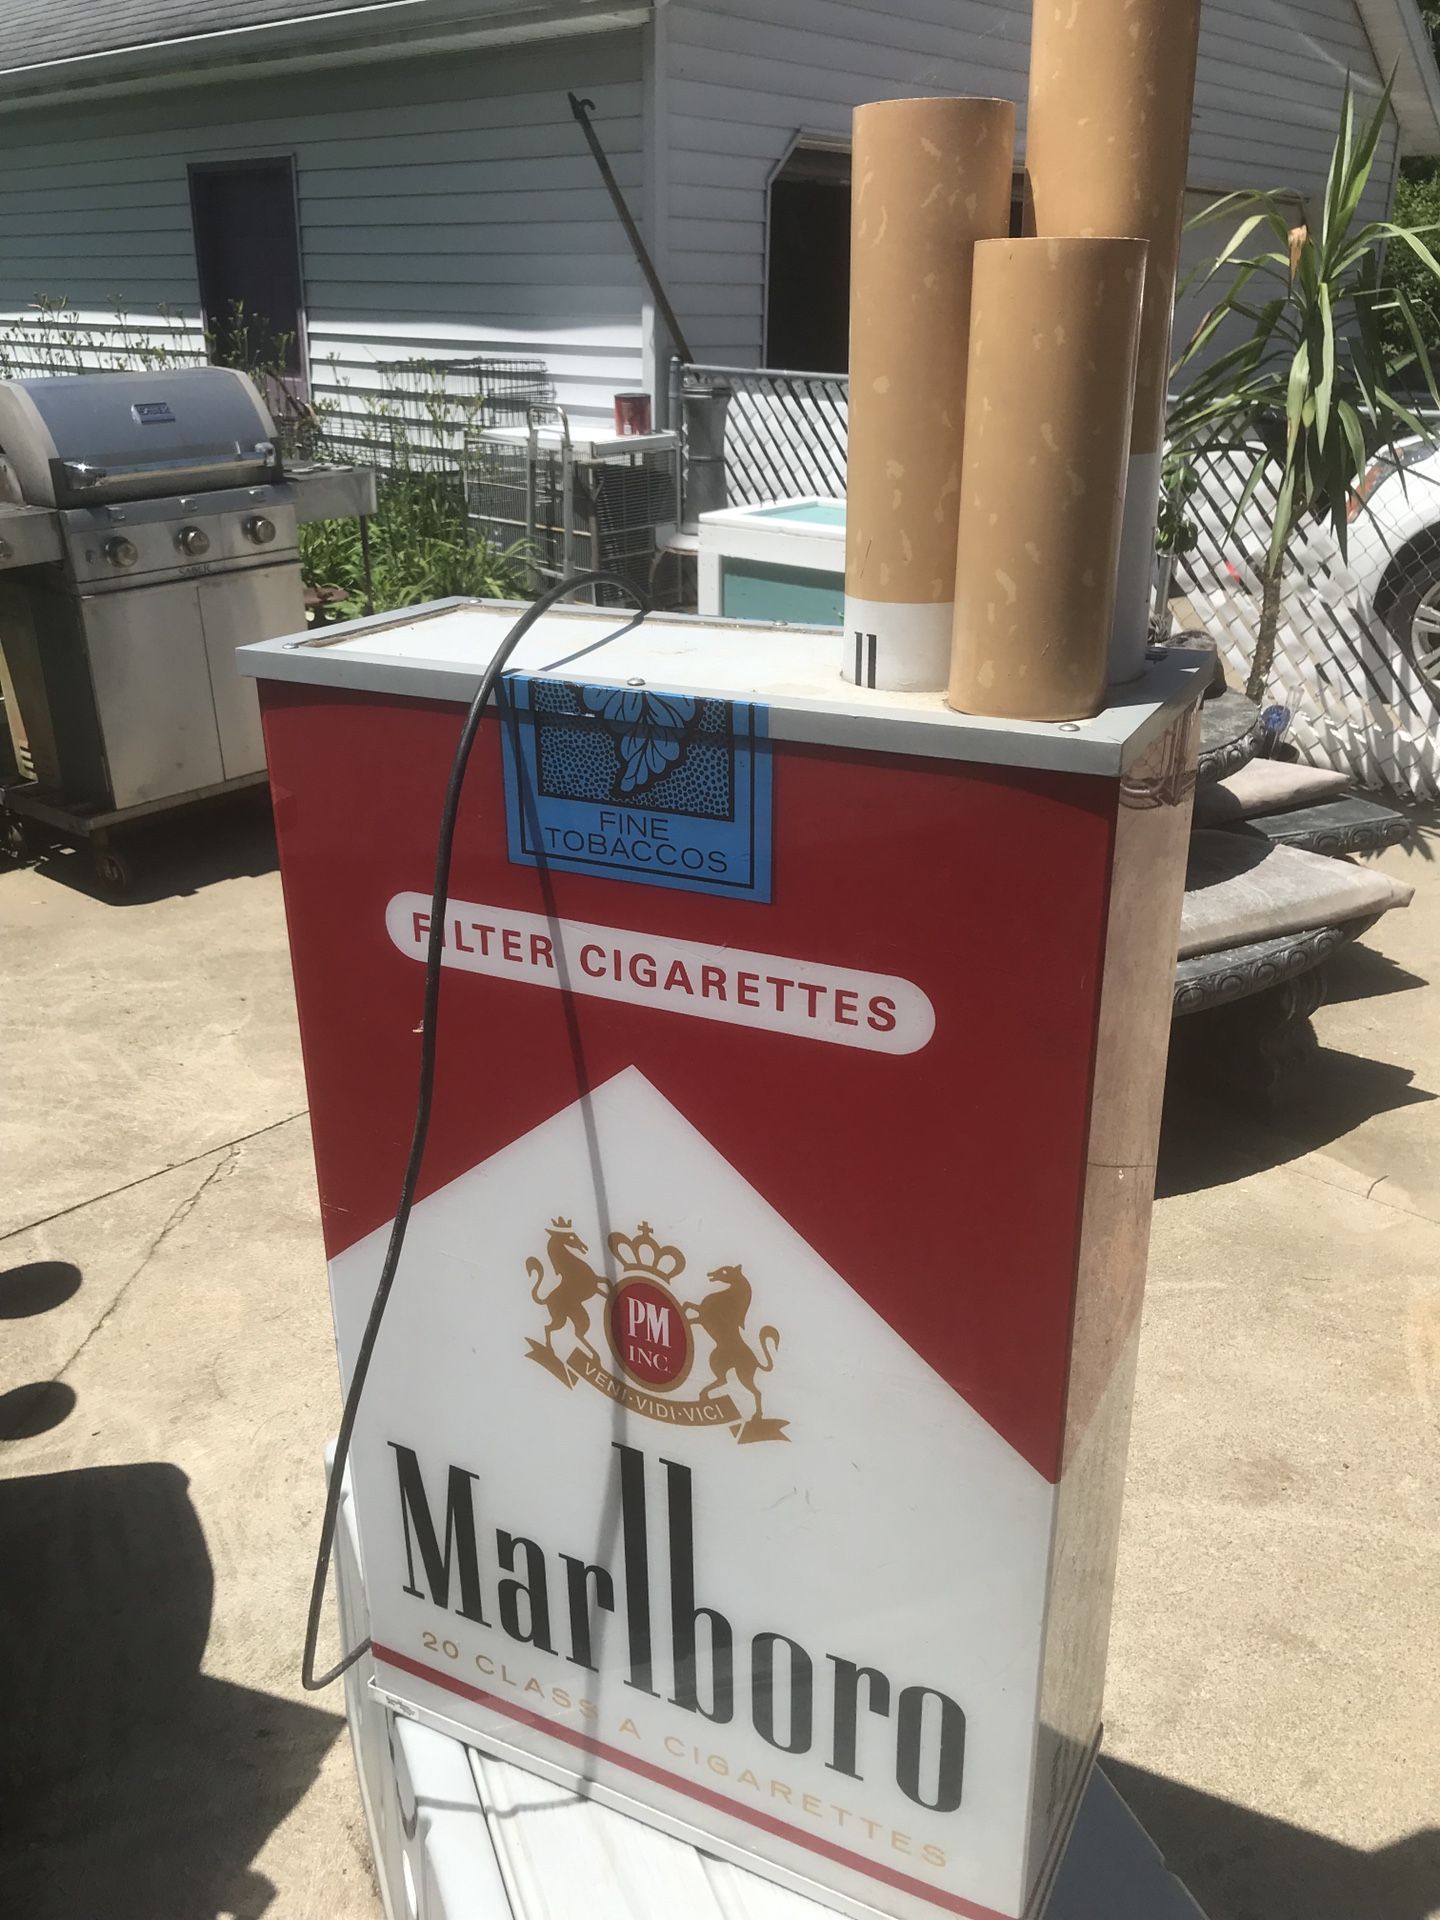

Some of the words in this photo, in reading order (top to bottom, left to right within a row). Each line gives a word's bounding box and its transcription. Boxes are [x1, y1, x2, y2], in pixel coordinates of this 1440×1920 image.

[544, 826, 728, 873] TOBACCOS
[599, 811, 670, 842] FINE
[412, 911, 554, 969] FLTER
[578, 944, 898, 1033] CIGARETTES
[626, 1296, 672, 1349] PM
[386, 1440, 967, 1814] Marlboro
[422, 1631, 459, 1660] 20
[475, 1654, 599, 1720] CLASS
[618, 1717, 642, 1740] A
[663, 1735, 948, 1869] CIGARETTES
